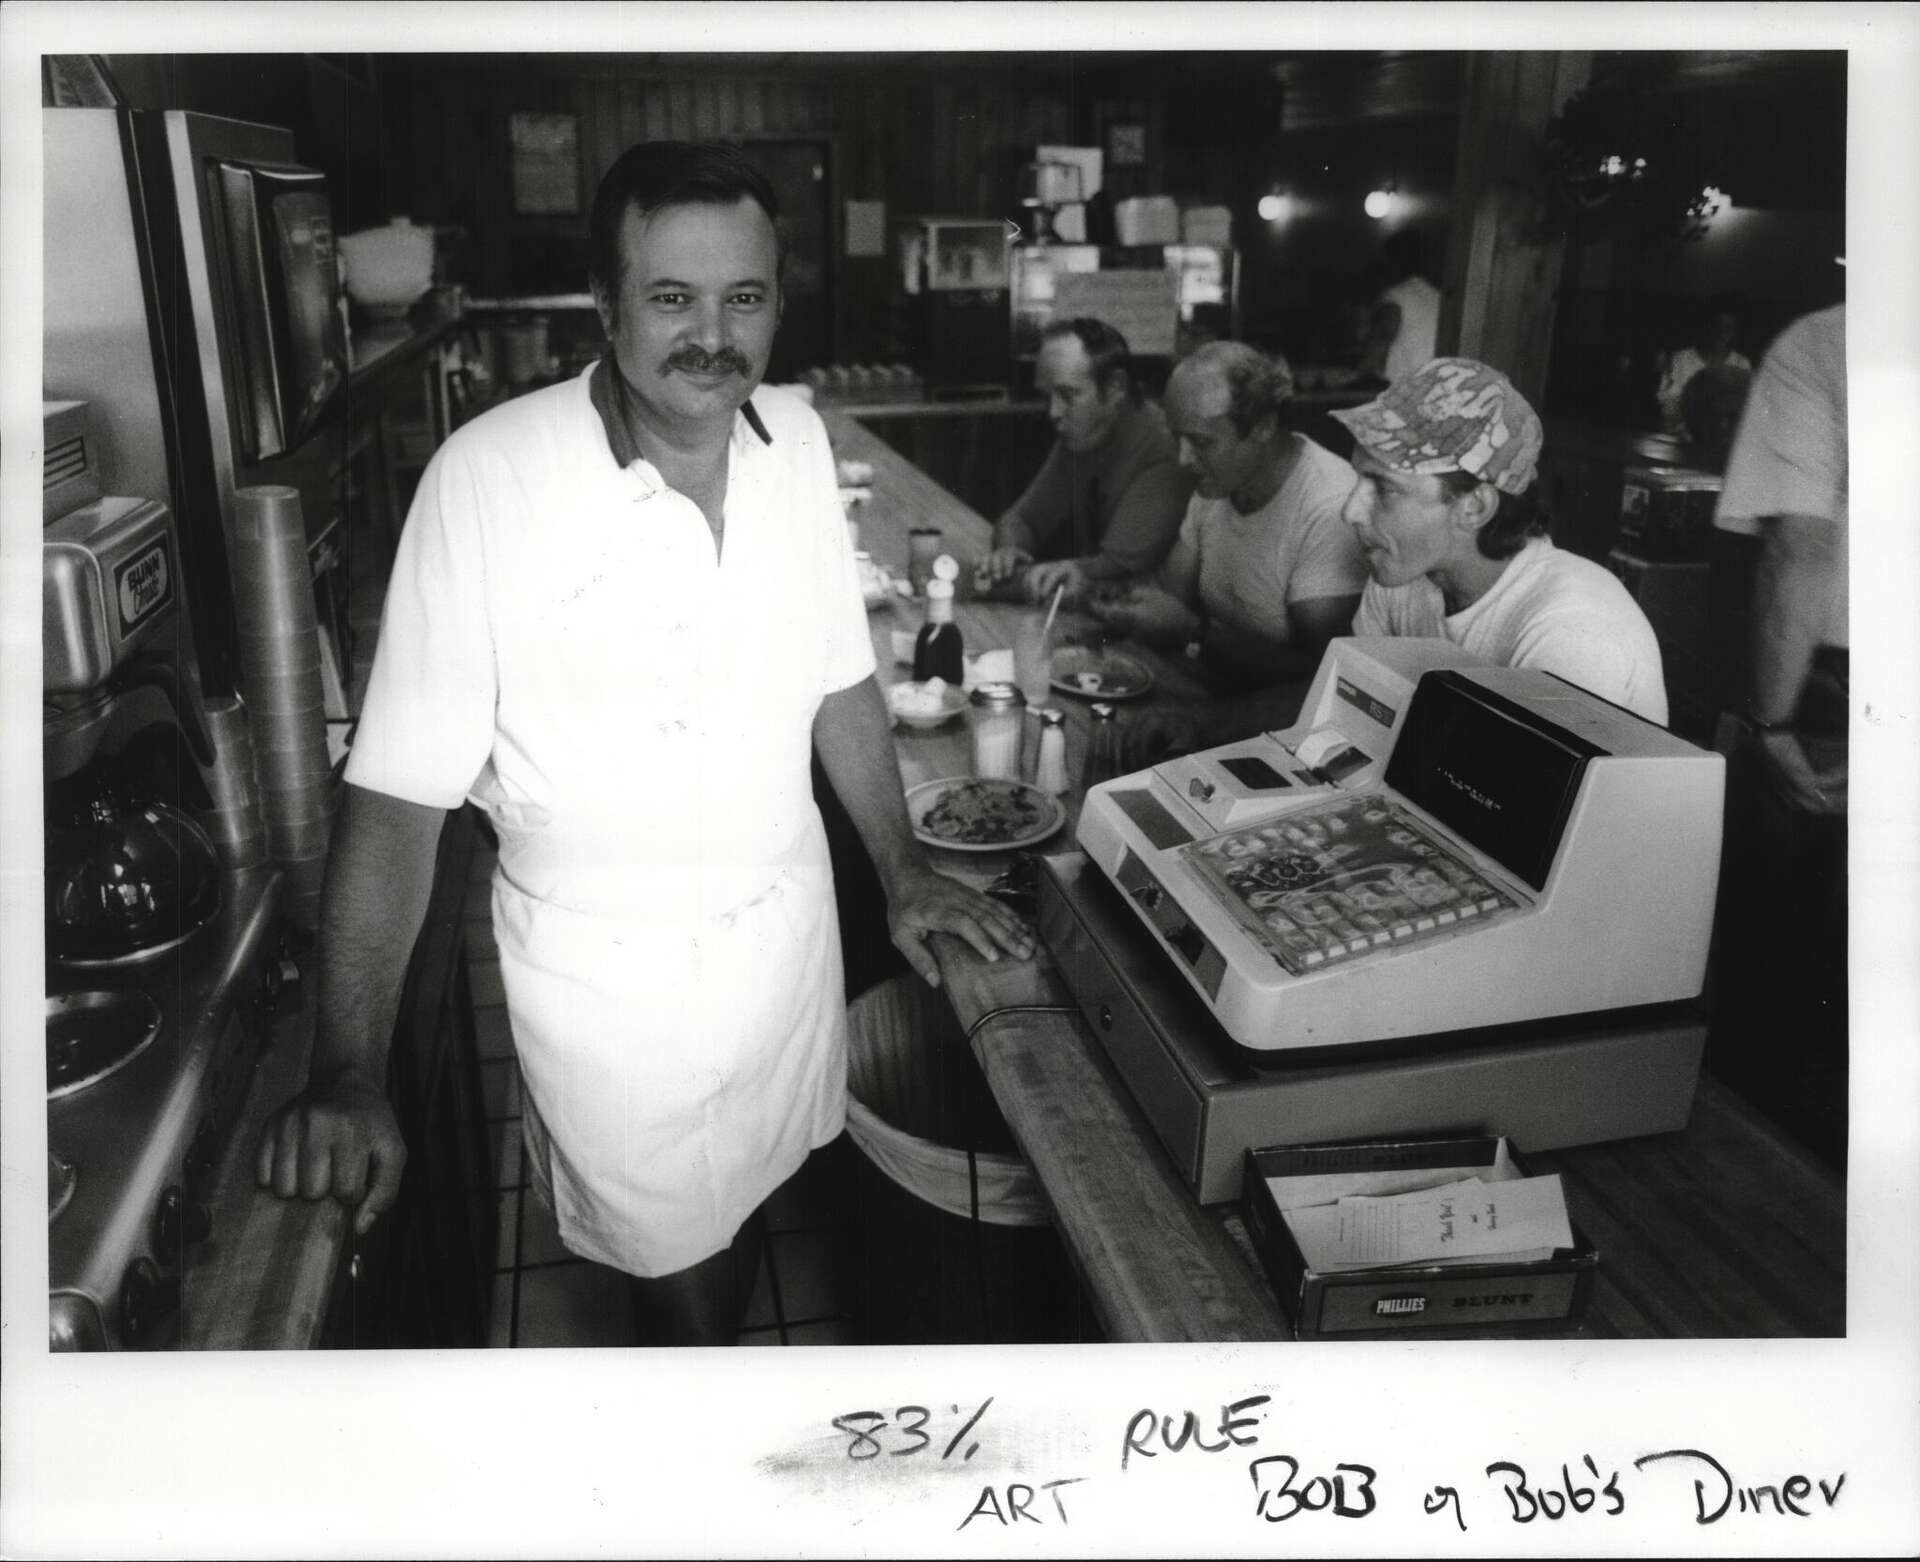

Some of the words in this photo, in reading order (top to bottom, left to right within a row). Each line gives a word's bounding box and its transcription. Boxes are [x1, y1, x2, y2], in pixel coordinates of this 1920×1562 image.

[127, 552, 160, 592] BUNN
[1375, 1297, 1426, 1315] PHILLIES
[1452, 1293, 1534, 1308] BLUNT
[833, 1397, 995, 1461] 83%
[1121, 1395, 1271, 1471] RULE
[956, 1477, 1088, 1531] ART
